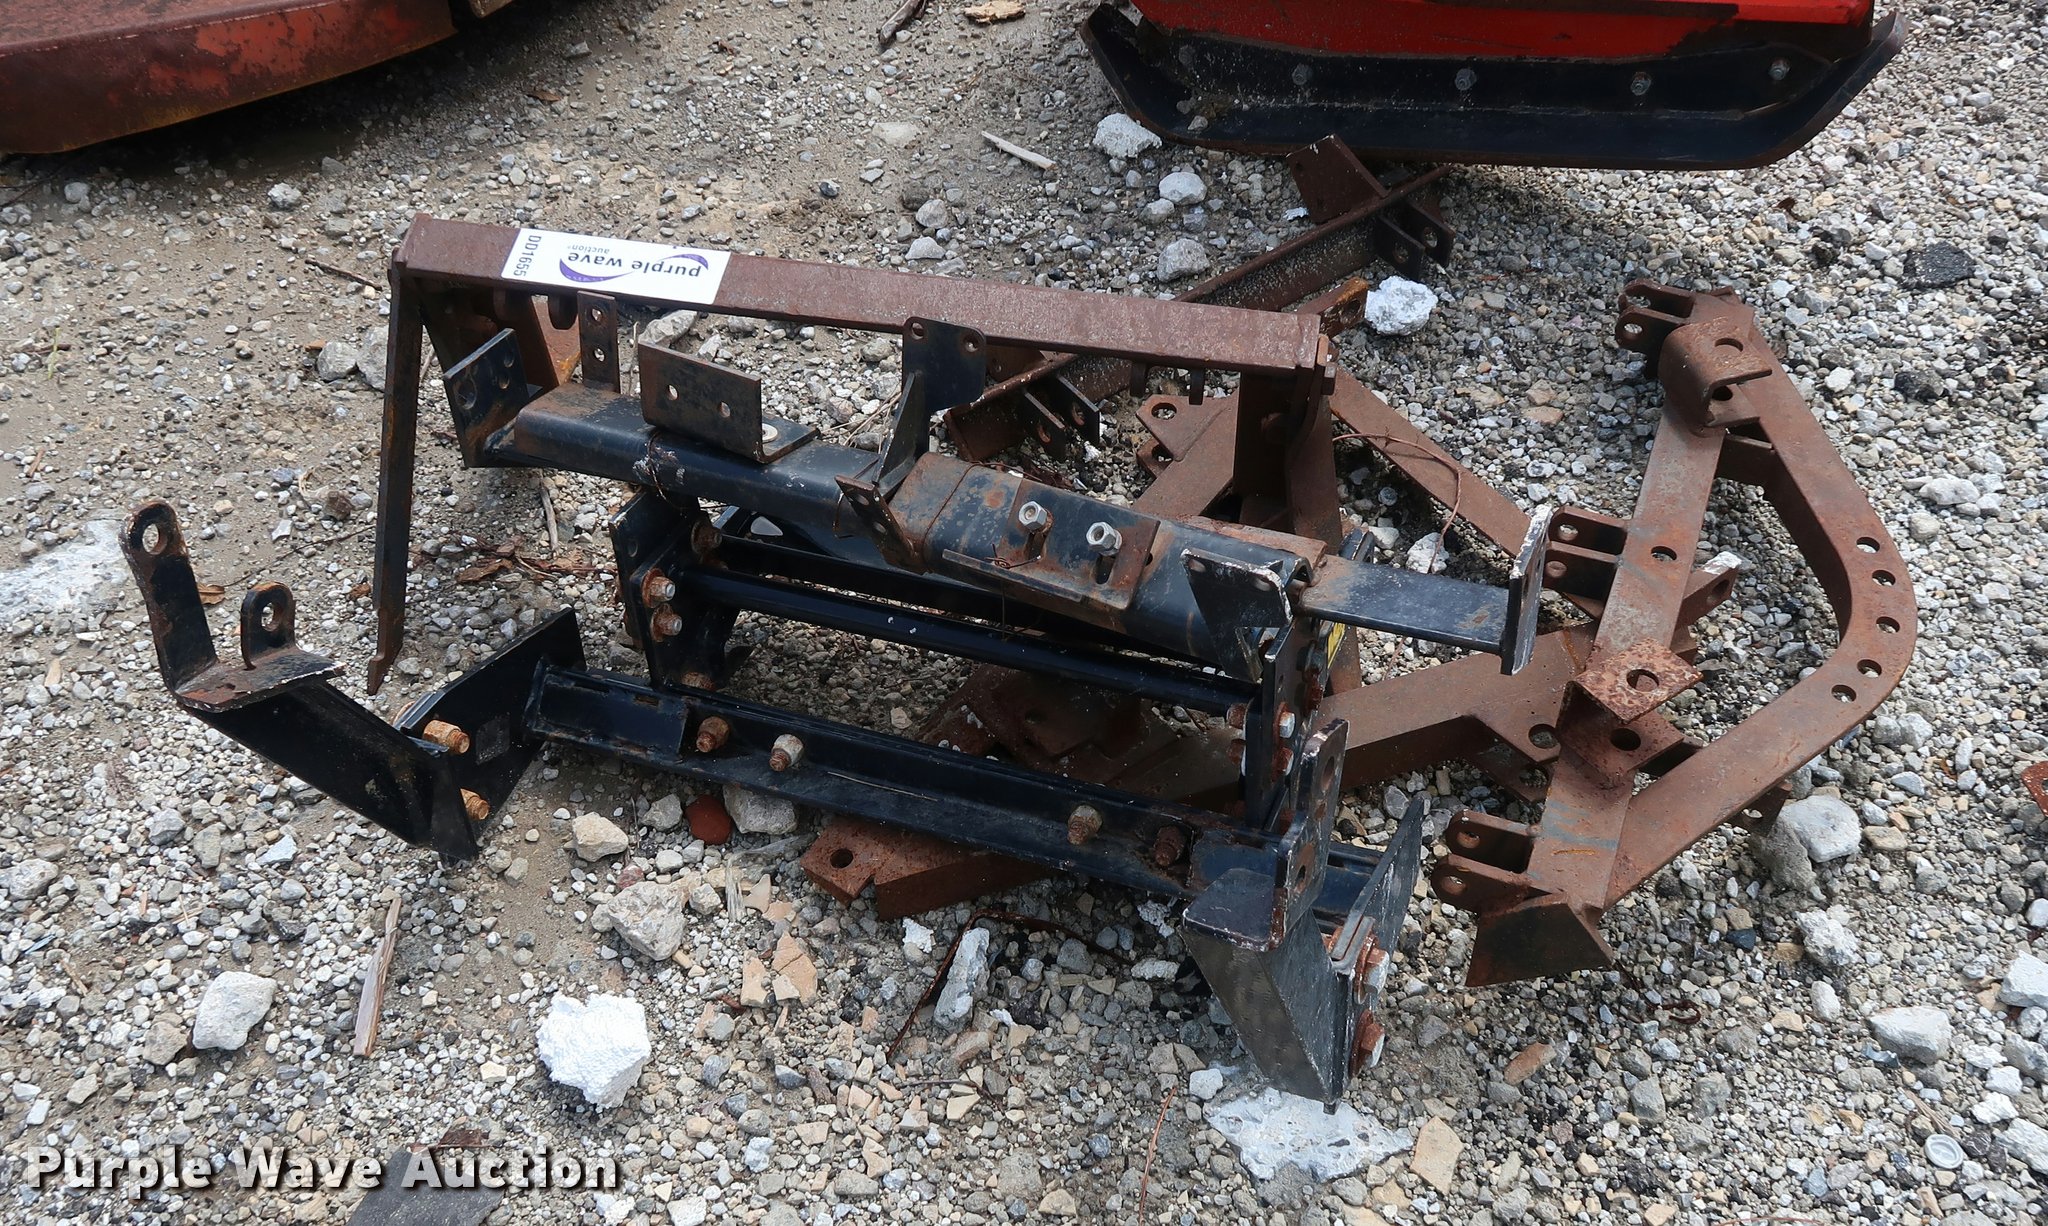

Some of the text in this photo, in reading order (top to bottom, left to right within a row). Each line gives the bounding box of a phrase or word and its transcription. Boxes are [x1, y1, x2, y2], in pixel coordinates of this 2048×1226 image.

[513, 235, 542, 277] DD1655
[568, 252, 702, 277] purple wave
